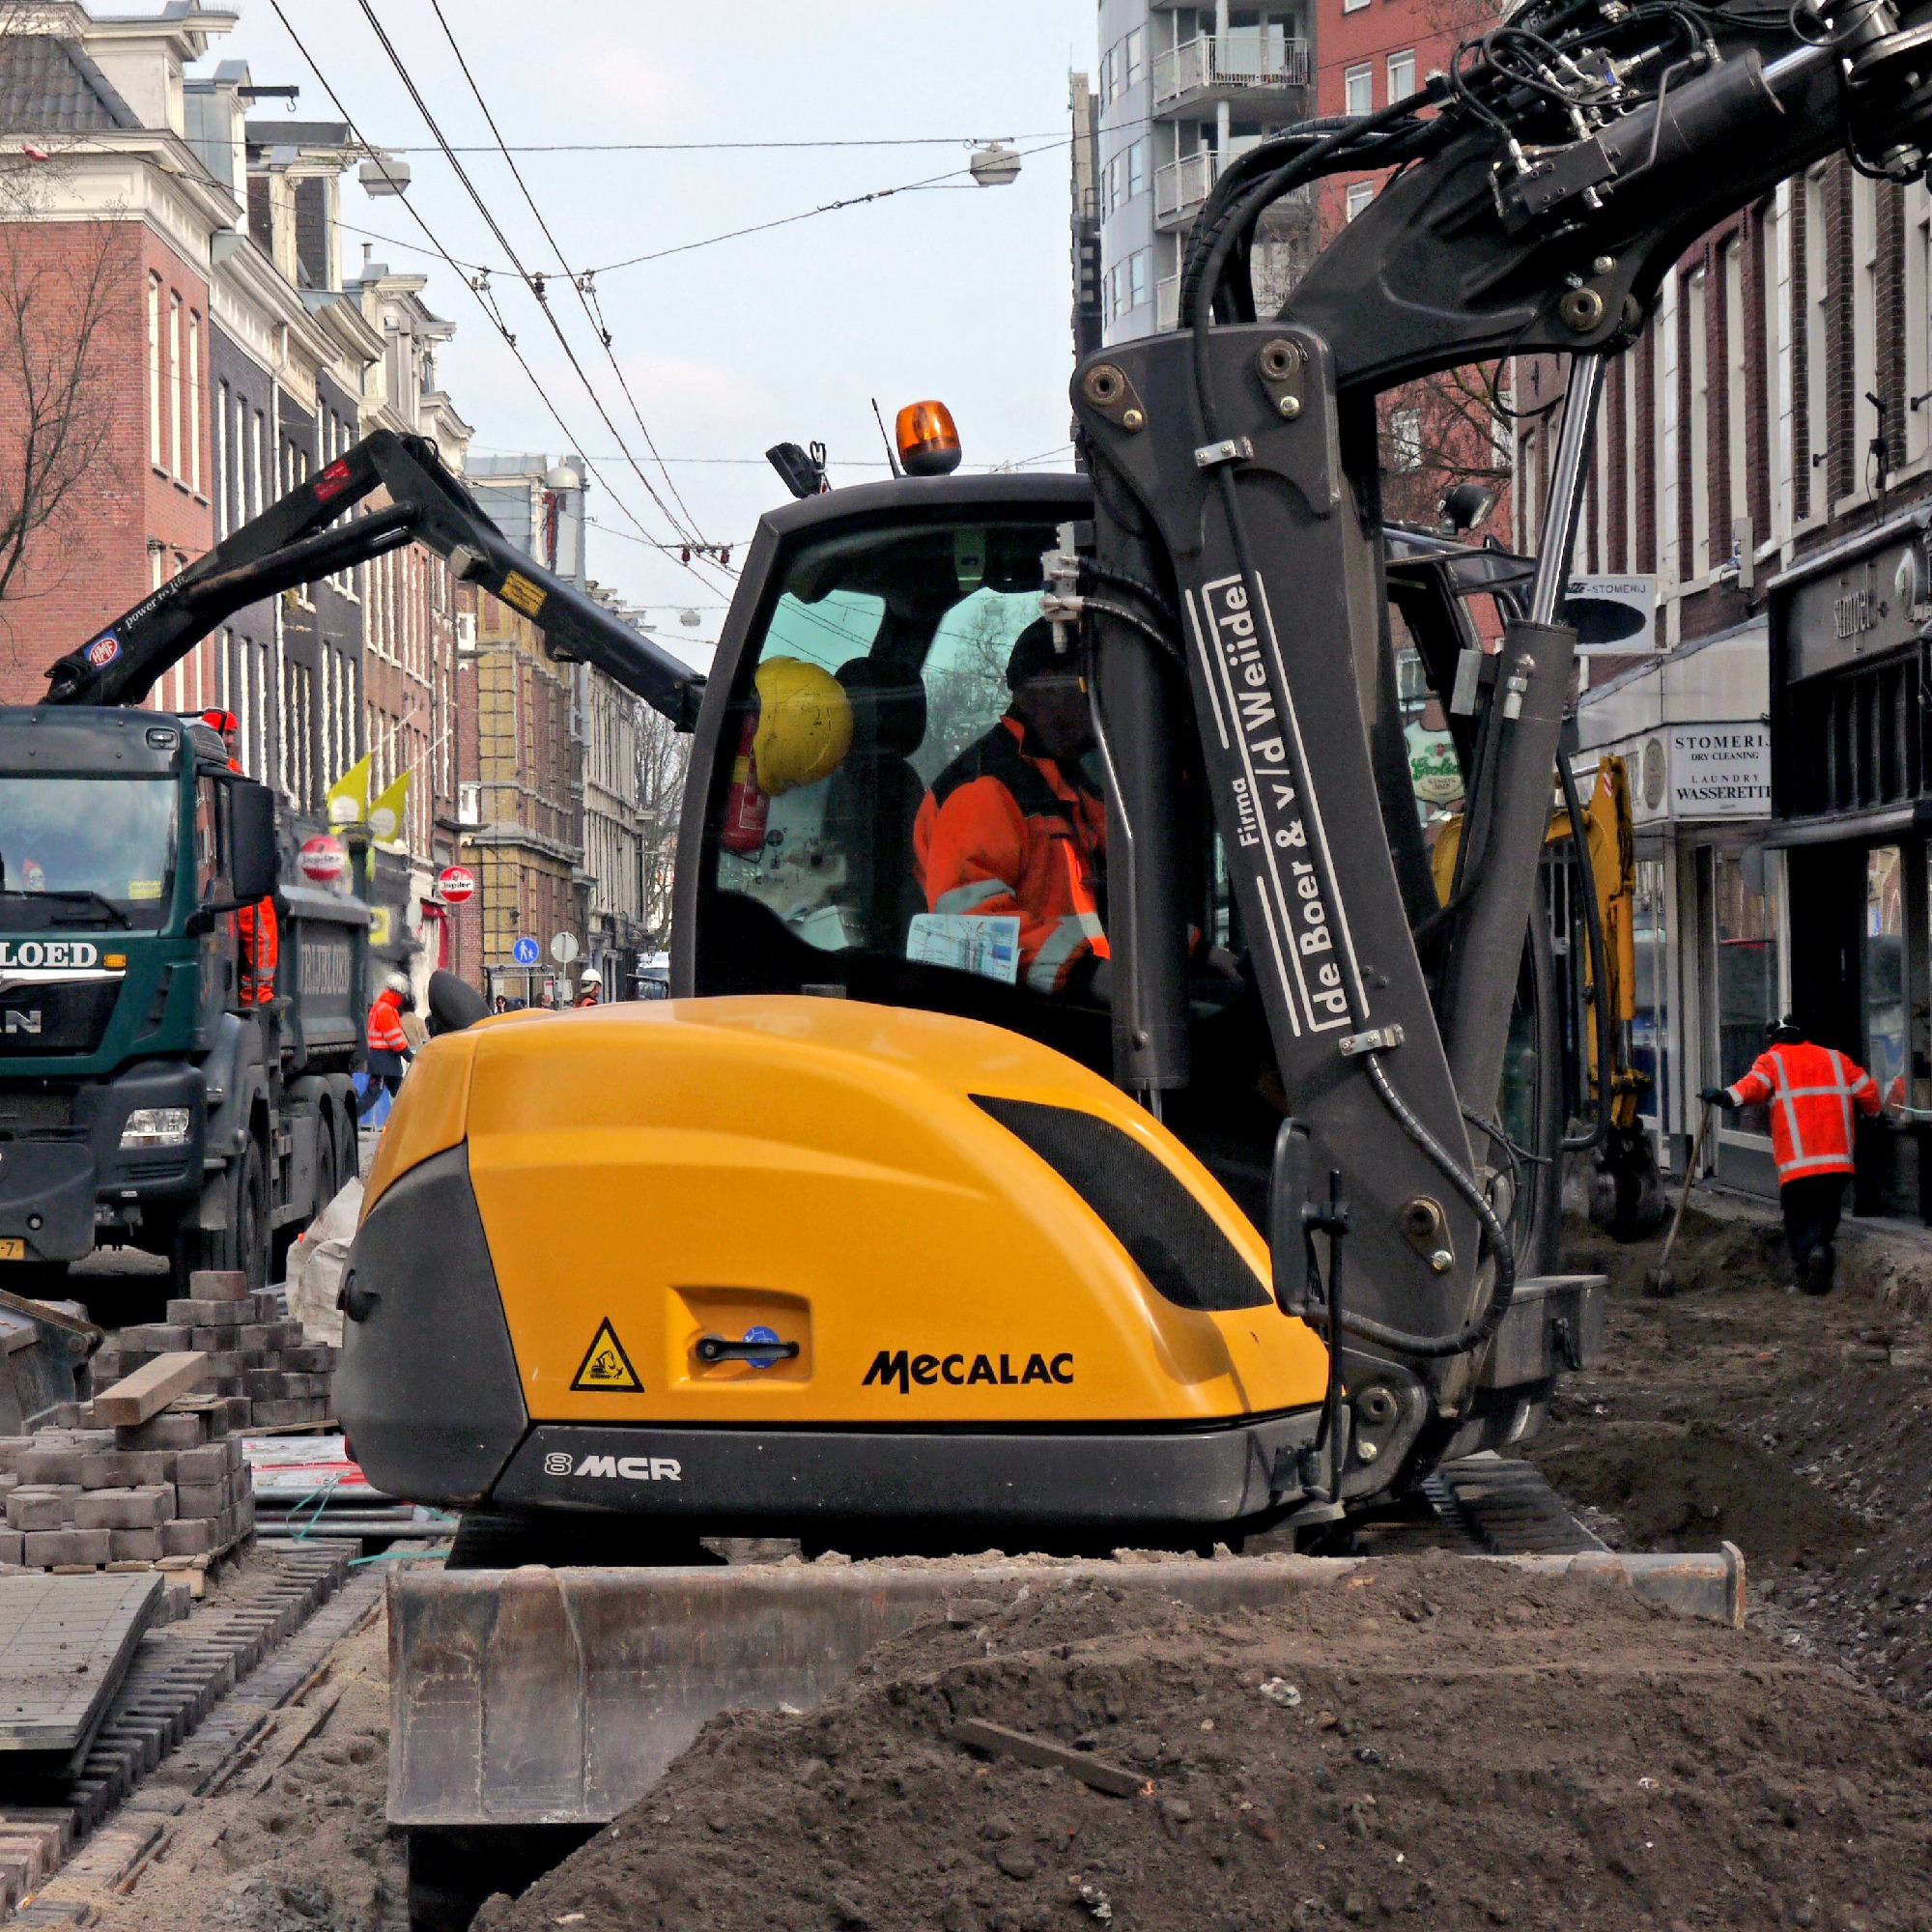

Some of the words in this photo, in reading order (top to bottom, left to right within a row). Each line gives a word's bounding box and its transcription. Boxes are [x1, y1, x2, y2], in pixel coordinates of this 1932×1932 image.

[125, 599, 156, 629] power
[92, 639, 115, 663] HMF
[1691, 753, 1709, 761] DRY
[1712, 752, 1759, 760] CLEANING
[1691, 774, 1759, 783] LAUNDRY
[1233, 778, 1260, 847] Firma
[1275, 818, 1307, 848] &
[441, 879, 471, 891] Jupiler
[1291, 861, 1333, 955] Boer
[1312, 962, 1348, 1013] de
[0, 1010, 42, 1034] N
[544, 1452, 573, 1476] 8
[574, 1455, 682, 1481] MCR
